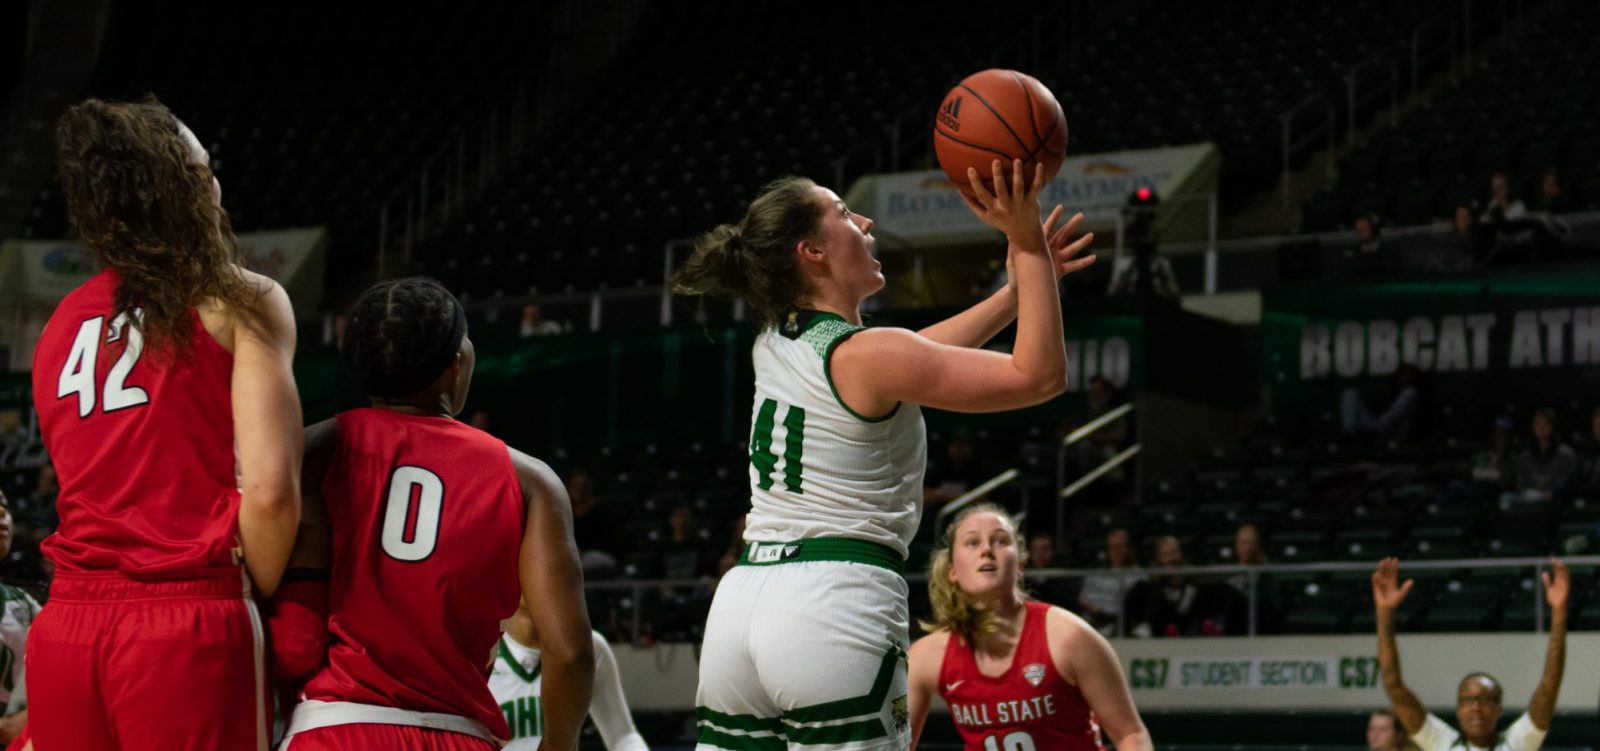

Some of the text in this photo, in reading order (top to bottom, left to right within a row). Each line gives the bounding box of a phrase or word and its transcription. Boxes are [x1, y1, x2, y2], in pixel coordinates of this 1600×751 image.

[57, 307, 149, 419] 42
[1300, 305, 1600, 381] BOBCAT ATH
[751, 398, 805, 494] 41
[381, 464, 446, 563] 0
[952, 693, 1056, 725] BALL STATE
[1130, 656, 1380, 688] CS7 STUDENT SECTION CS7
